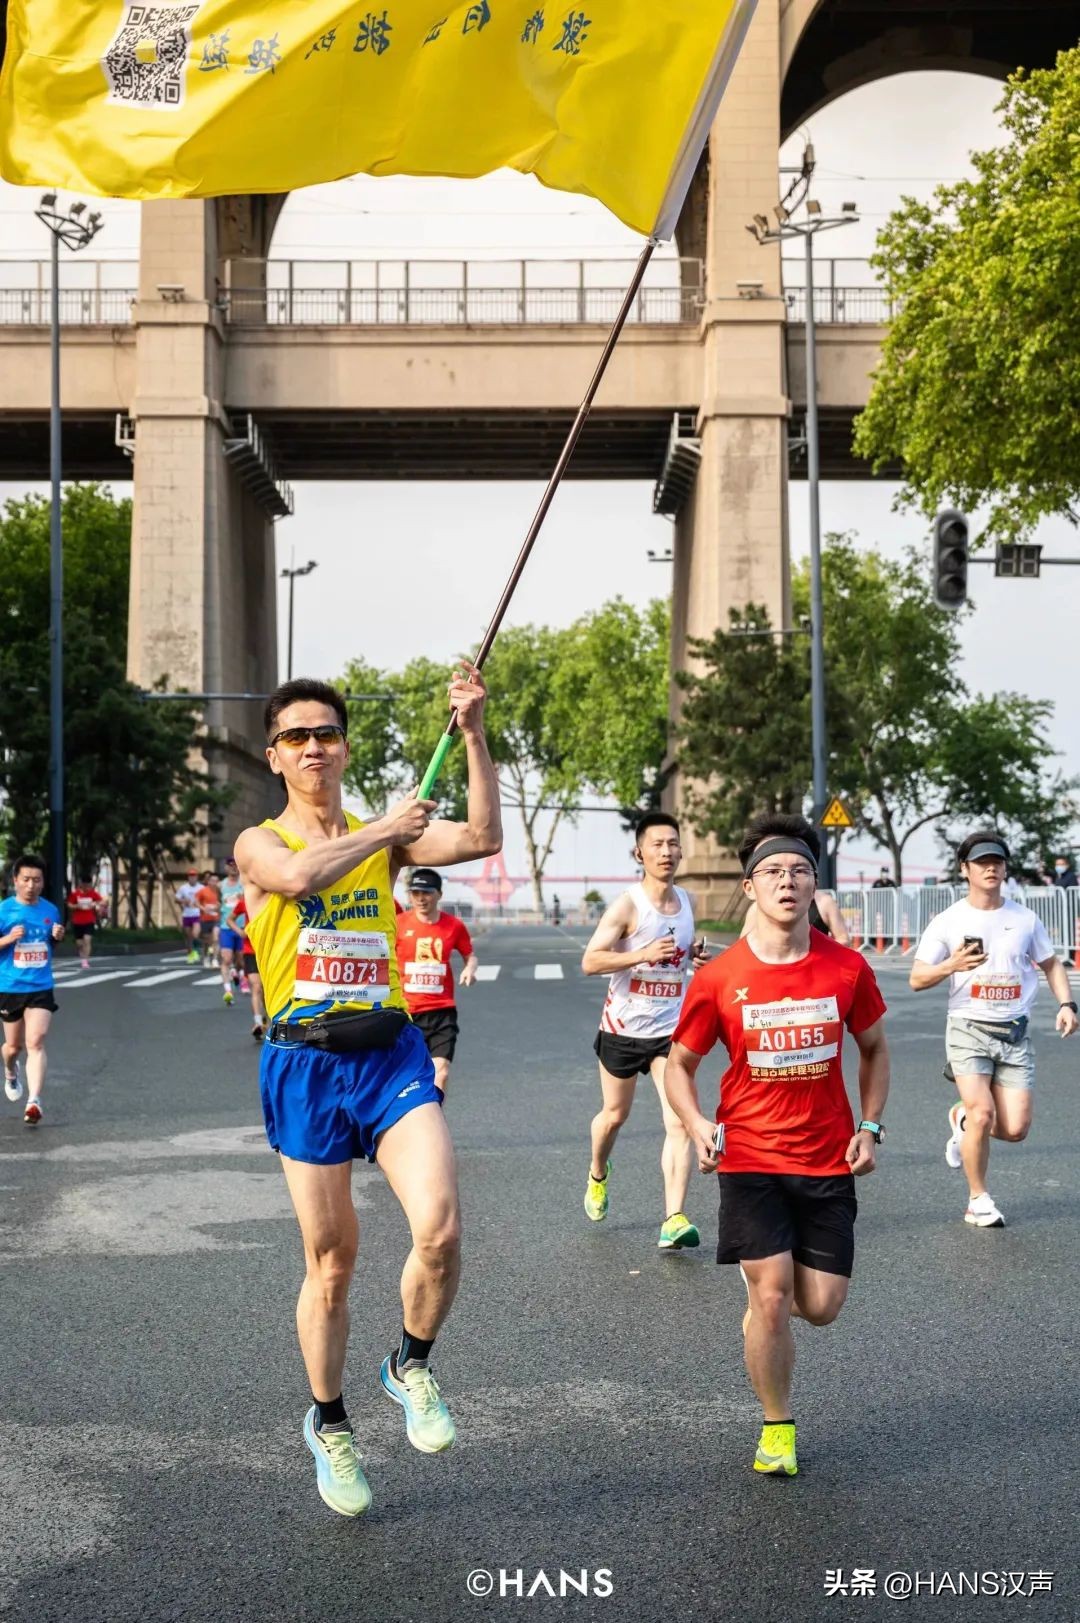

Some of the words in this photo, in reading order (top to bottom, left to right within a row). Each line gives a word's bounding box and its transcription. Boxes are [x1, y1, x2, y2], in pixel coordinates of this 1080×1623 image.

[331, 904, 379, 922] RUNNER
[310, 956, 378, 984] A0873
[637, 982, 678, 997] A1679
[977, 985, 1016, 1000] A0863
[758, 1027, 825, 1051] A0155
